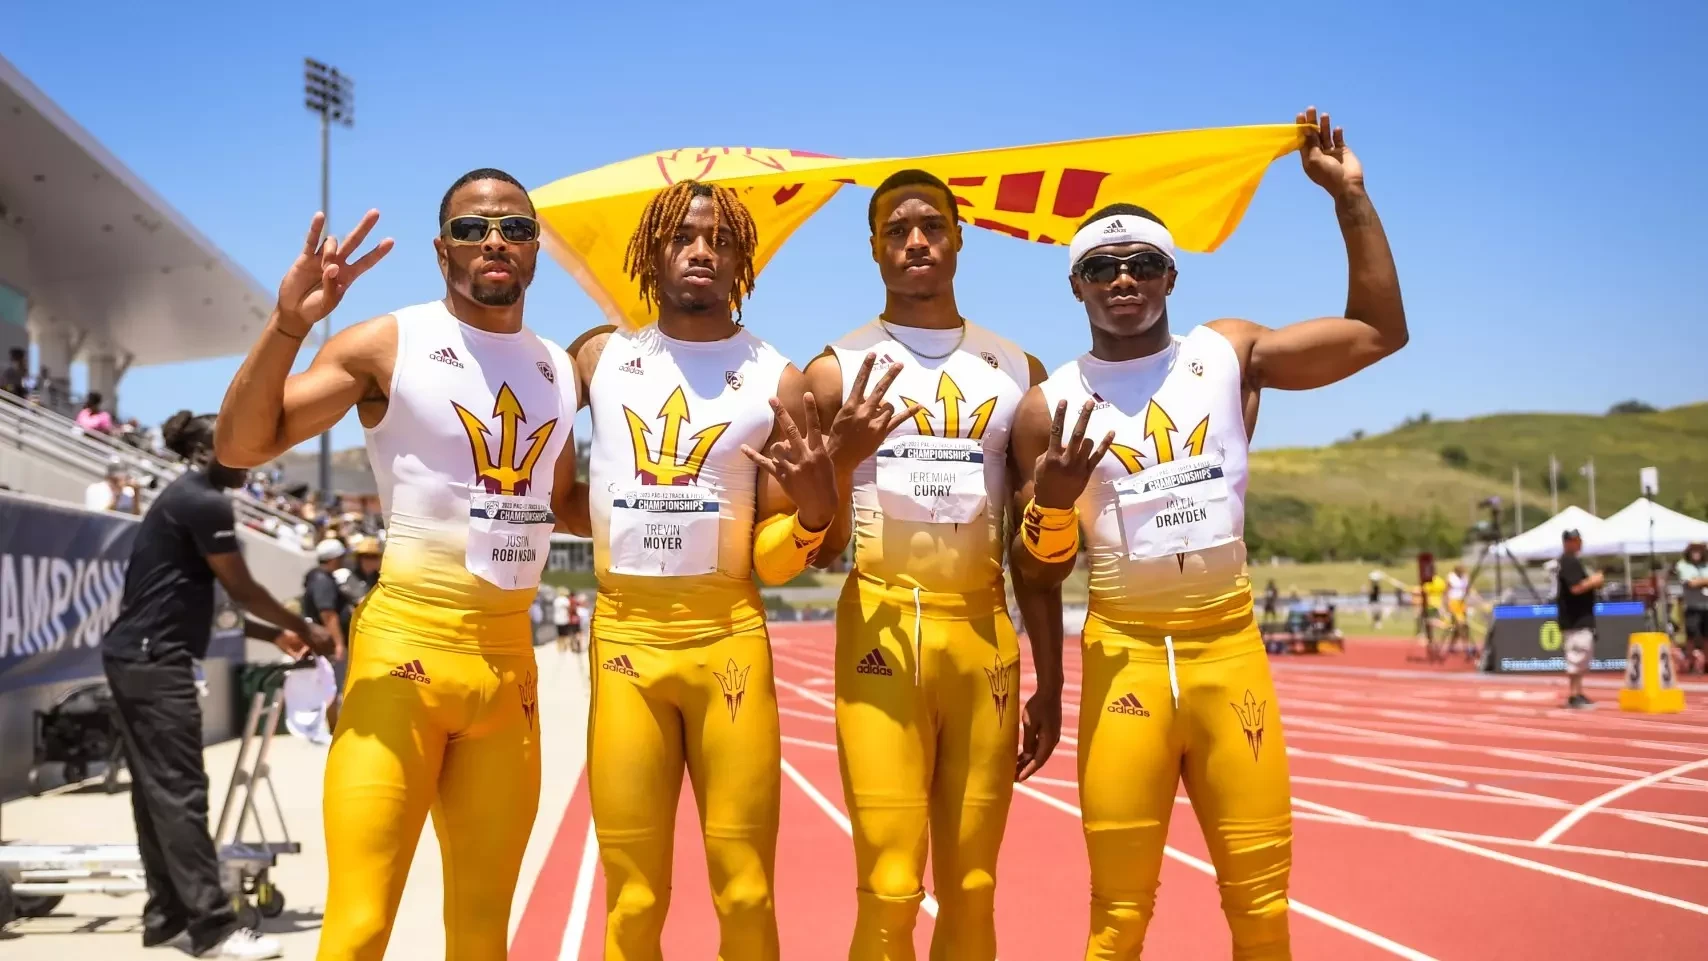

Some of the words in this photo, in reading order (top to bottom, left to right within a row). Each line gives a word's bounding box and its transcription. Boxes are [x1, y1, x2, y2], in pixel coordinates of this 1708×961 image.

[429, 353, 465, 369] adidas
[618, 365, 645, 376] adidas
[907, 449, 971, 461] CHAMPIONSHIPS
[908, 472, 956, 484] JEREMIAH
[1148, 467, 1213, 490] CHAMPIONSHIPS
[914, 484, 952, 497] CURRY
[638, 500, 704, 511] CHAMPIONSHIPS
[1156, 507, 1207, 528] DRAYDEN
[644, 523, 680, 536] TREVIN
[643, 537, 682, 550] MOYER
[491, 548, 536, 562] ROBINSON
[0, 553, 128, 657] AMPION
[602, 662, 641, 679] adidas
[856, 664, 893, 677] adidas
[1630, 652, 1641, 683] 3
[1660, 652, 1671, 683] 3
[390, 668, 431, 685] adidas
[1107, 705, 1151, 718] adidas
